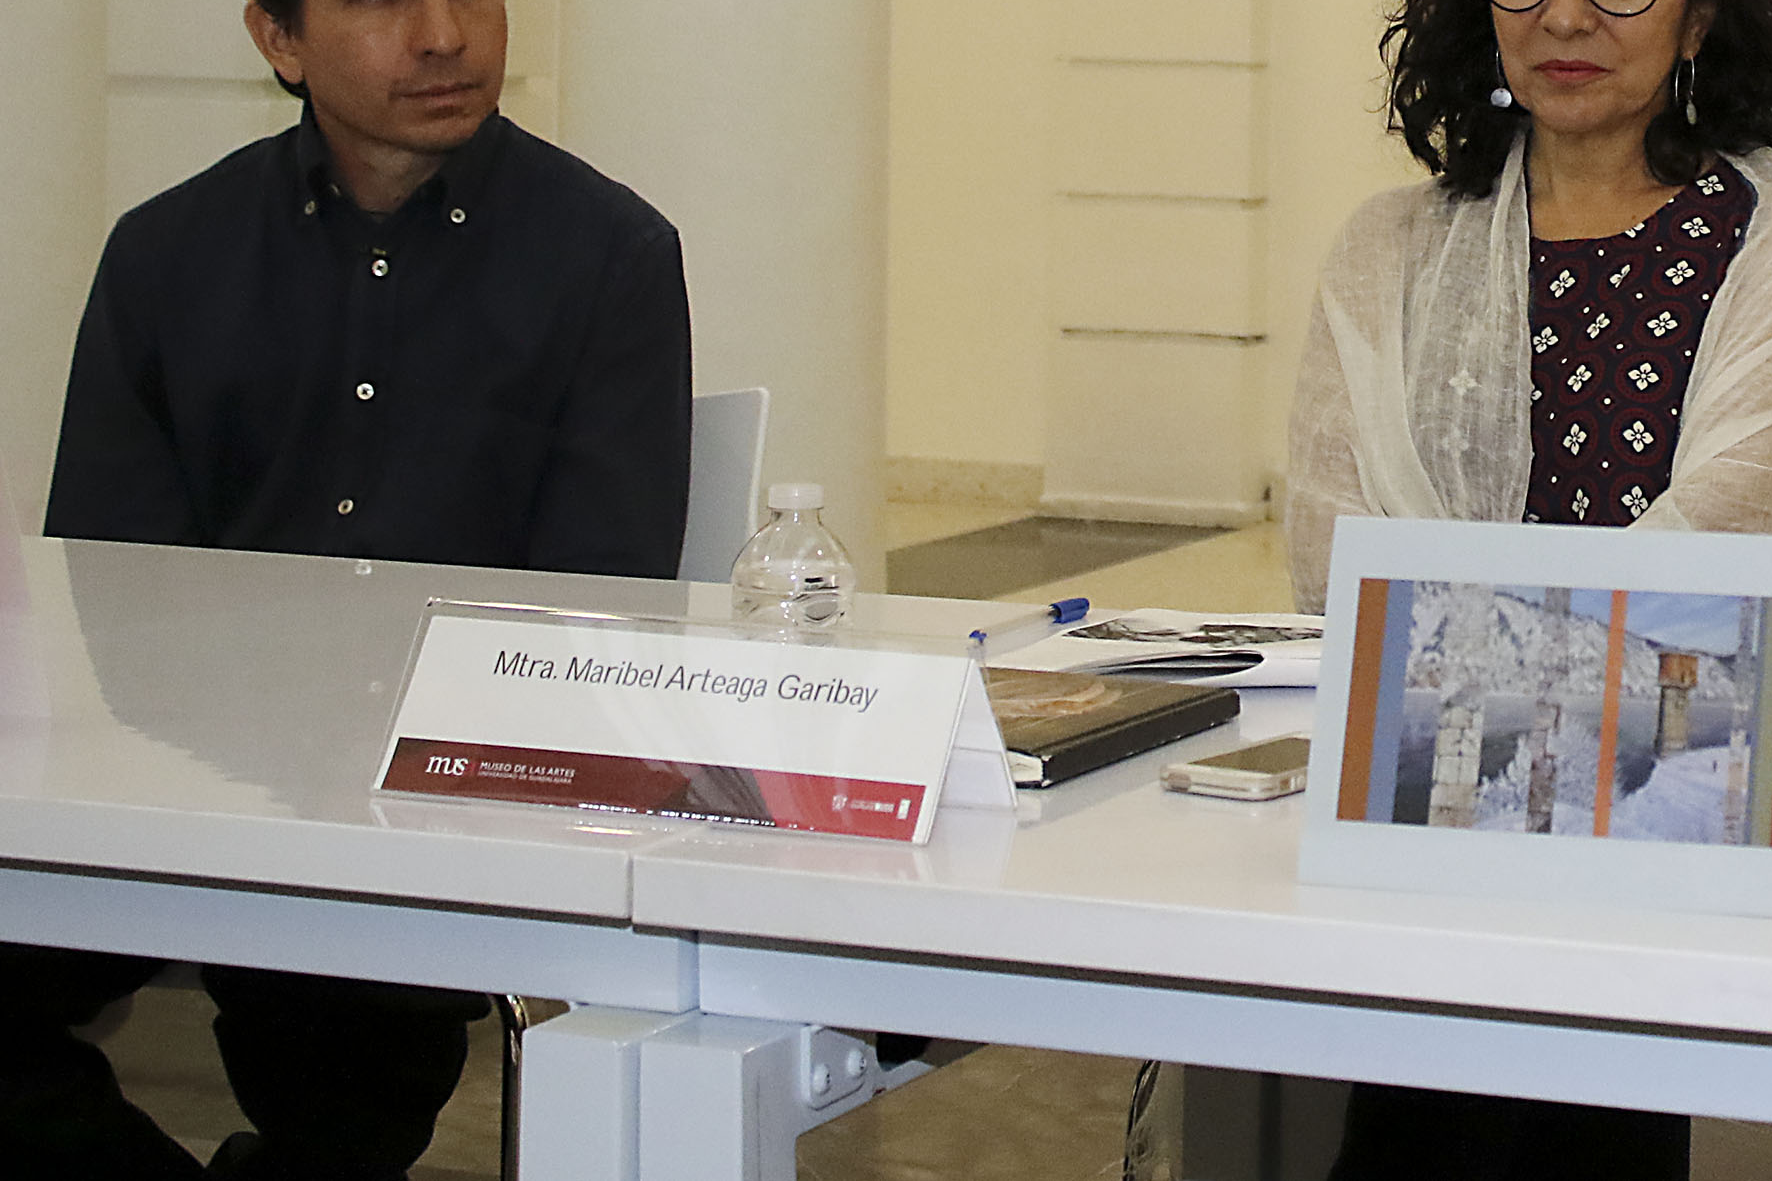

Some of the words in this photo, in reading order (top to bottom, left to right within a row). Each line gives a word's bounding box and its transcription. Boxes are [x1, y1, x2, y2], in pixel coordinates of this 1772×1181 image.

[493, 650, 557, 680] Mtra.
[565, 656, 663, 688] Maribel
[665, 665, 767, 702] Arteaga
[778, 674, 878, 711] Garibay
[479, 761, 512, 772] MUSEO
[514, 764, 527, 773] DE
[529, 766, 546, 775] LAS
[547, 767, 575, 778] ARTES
